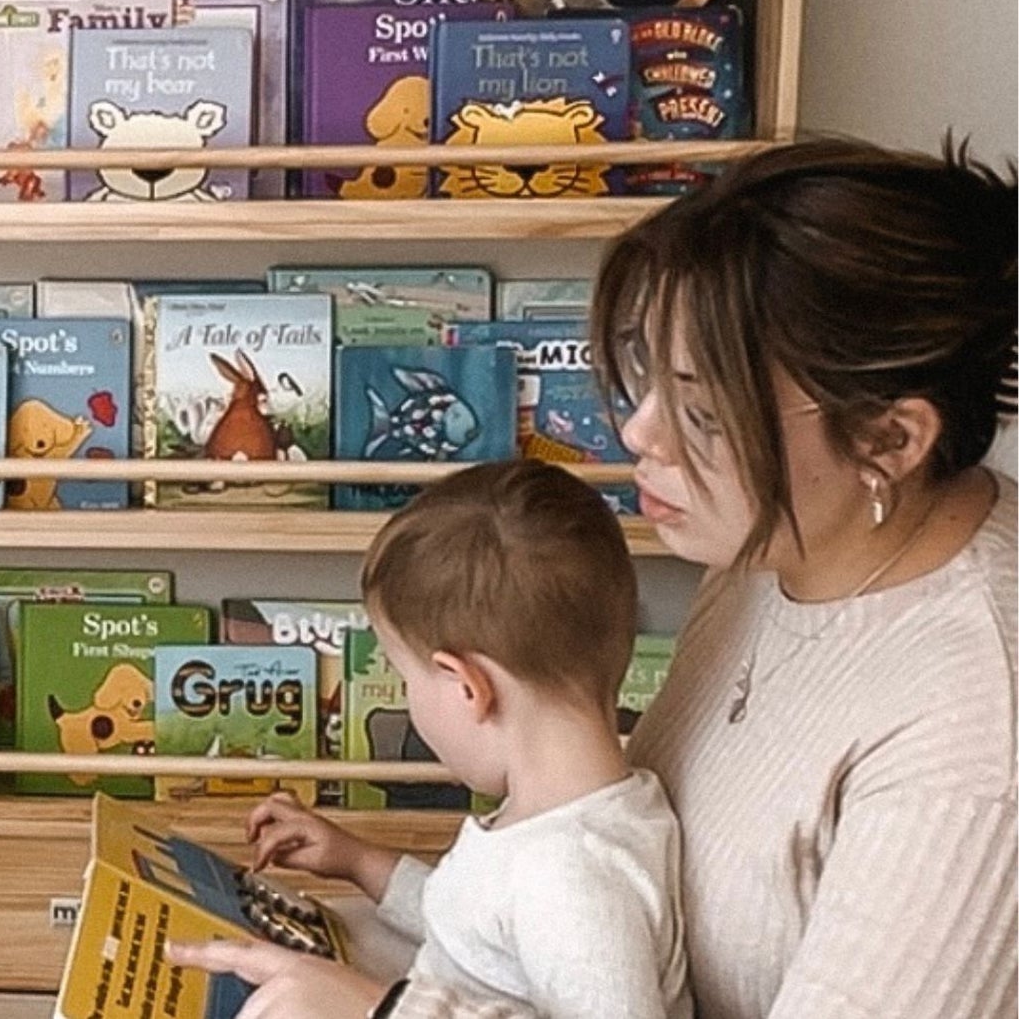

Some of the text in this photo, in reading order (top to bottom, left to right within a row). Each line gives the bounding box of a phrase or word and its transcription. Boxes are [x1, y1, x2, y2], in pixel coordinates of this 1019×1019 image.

[46, 6, 168, 33] Family
[106, 46, 215, 72] That's not
[368, 46, 409, 64] First
[471, 43, 589, 69] That's not
[105, 77, 142, 102] my
[478, 68, 568, 102] my lion
[0, 328, 78, 357] Spot's
[166, 322, 323, 352] A Tale of Tails
[24, 360, 95, 376] Numbers
[83, 612, 159, 640] Spot's
[72, 642, 109, 658] First
[171, 659, 304, 737] Grug
